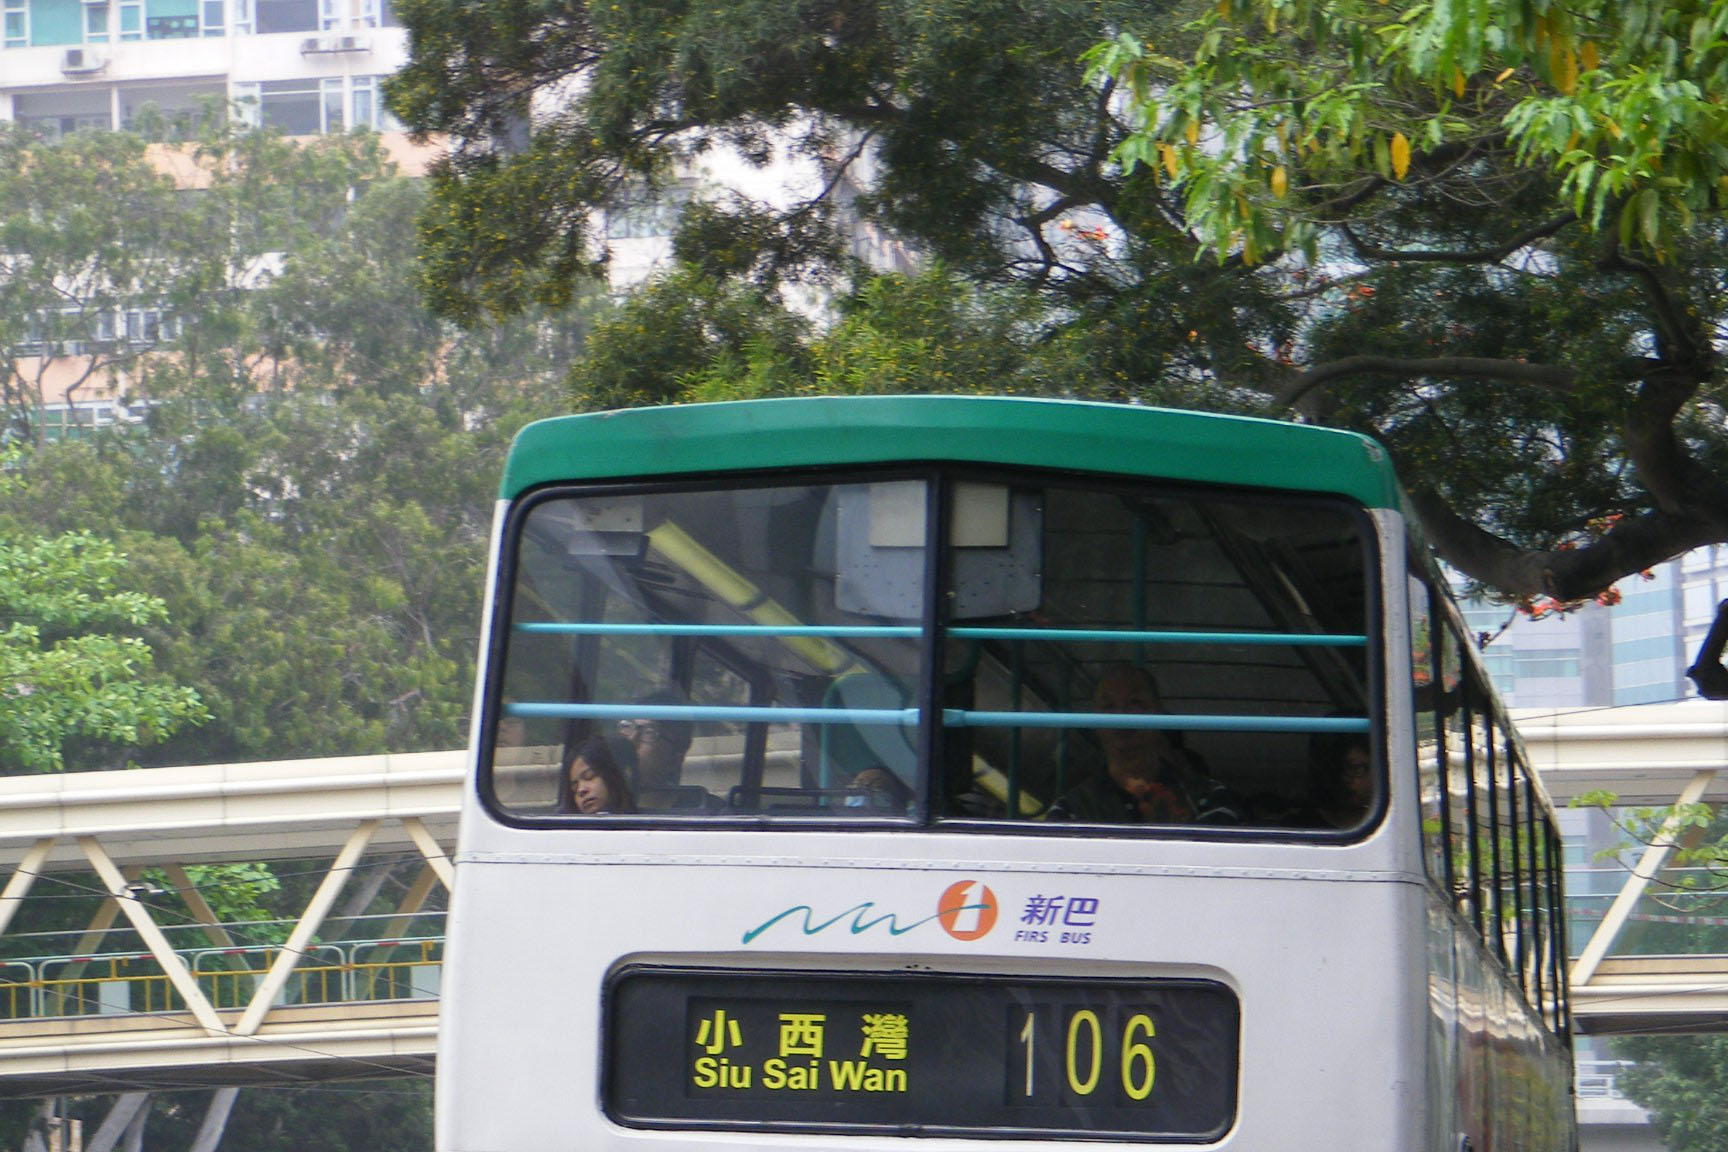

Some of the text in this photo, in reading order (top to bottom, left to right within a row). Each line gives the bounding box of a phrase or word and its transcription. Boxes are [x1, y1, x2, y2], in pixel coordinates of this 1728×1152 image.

[1020, 894, 1099, 926] 新巴
[1060, 932, 1092, 944] BUS
[695, 1009, 909, 1060] 小西灣
[1020, 1009, 1156, 1100] 106
[693, 1057, 908, 1092] Siu Sai Wan
